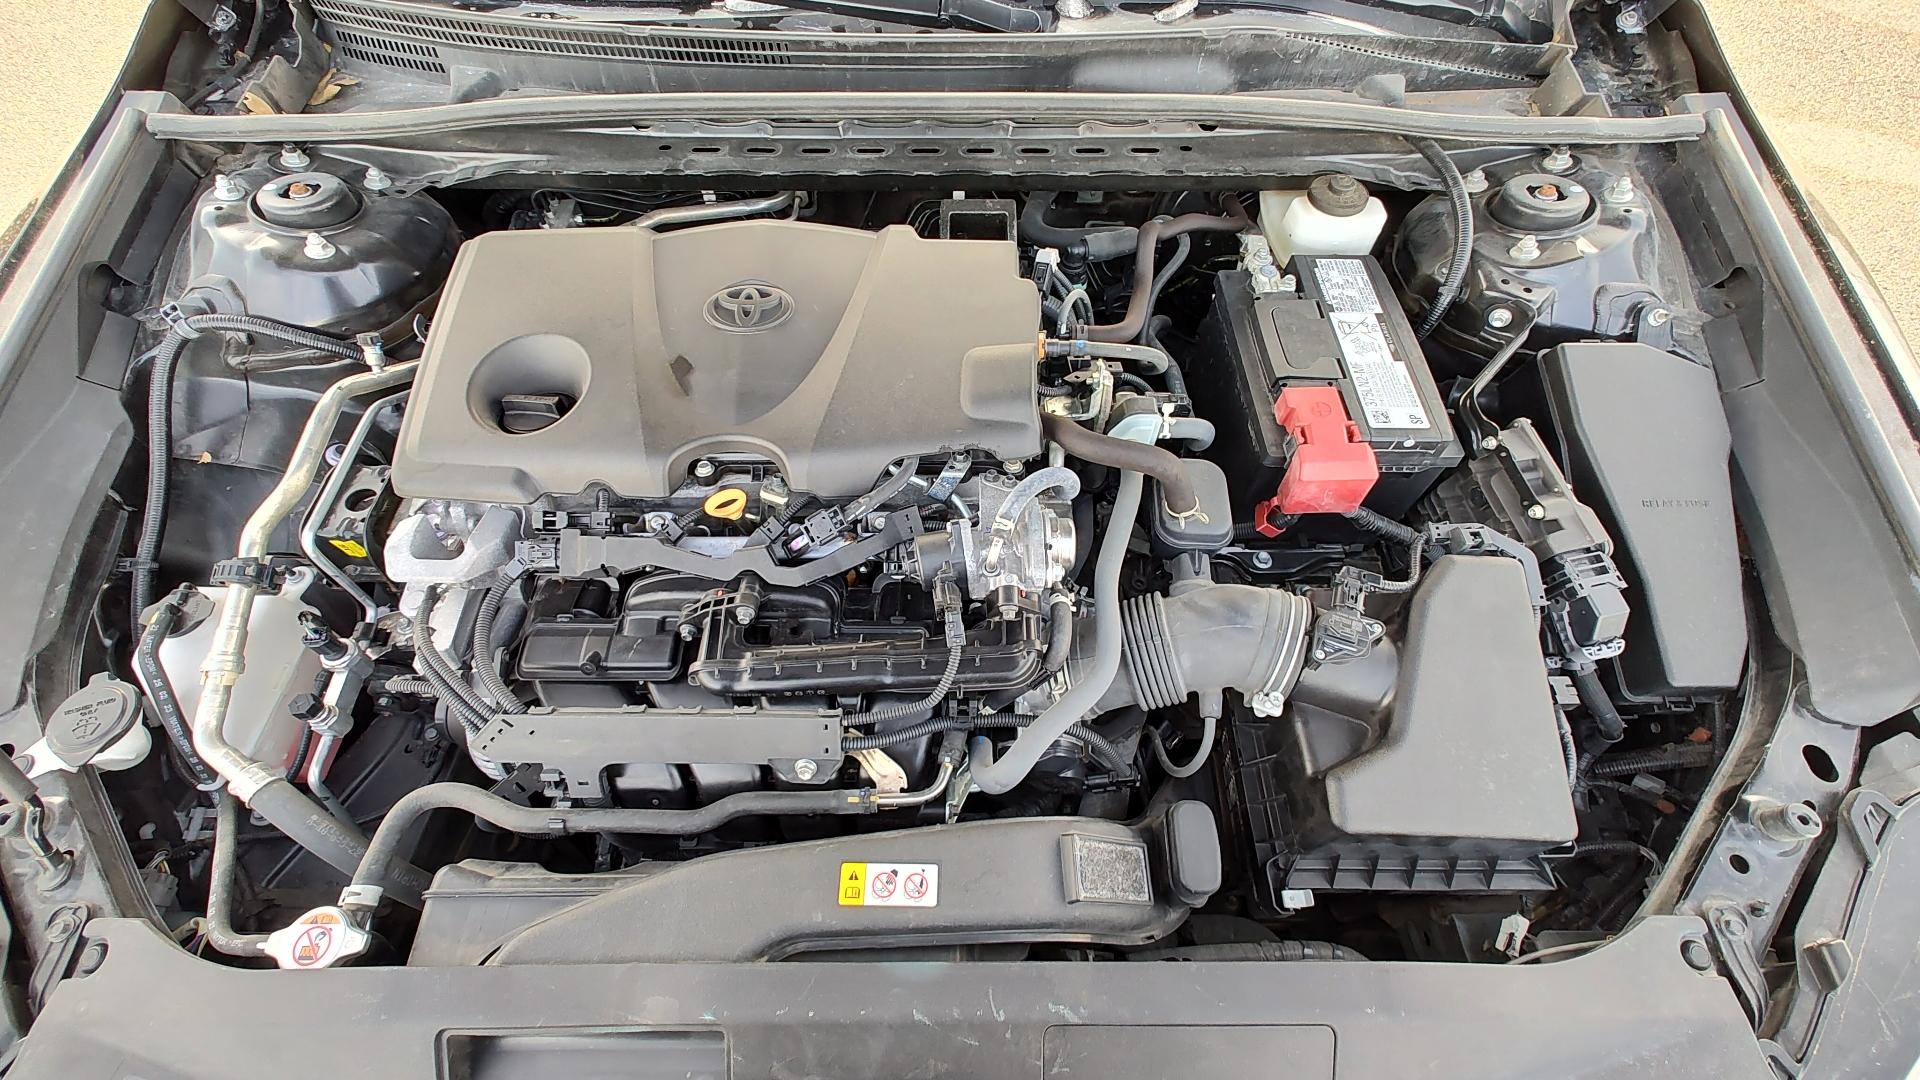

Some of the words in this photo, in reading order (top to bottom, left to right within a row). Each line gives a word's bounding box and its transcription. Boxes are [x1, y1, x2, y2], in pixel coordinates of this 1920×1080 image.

[1350, 361, 1378, 407] 375LN2-MF
[1409, 414, 1424, 425] SP
[143, 634, 155, 654] WATER
[164, 704, 173, 713] 23
[169, 715, 184, 737] WATER
